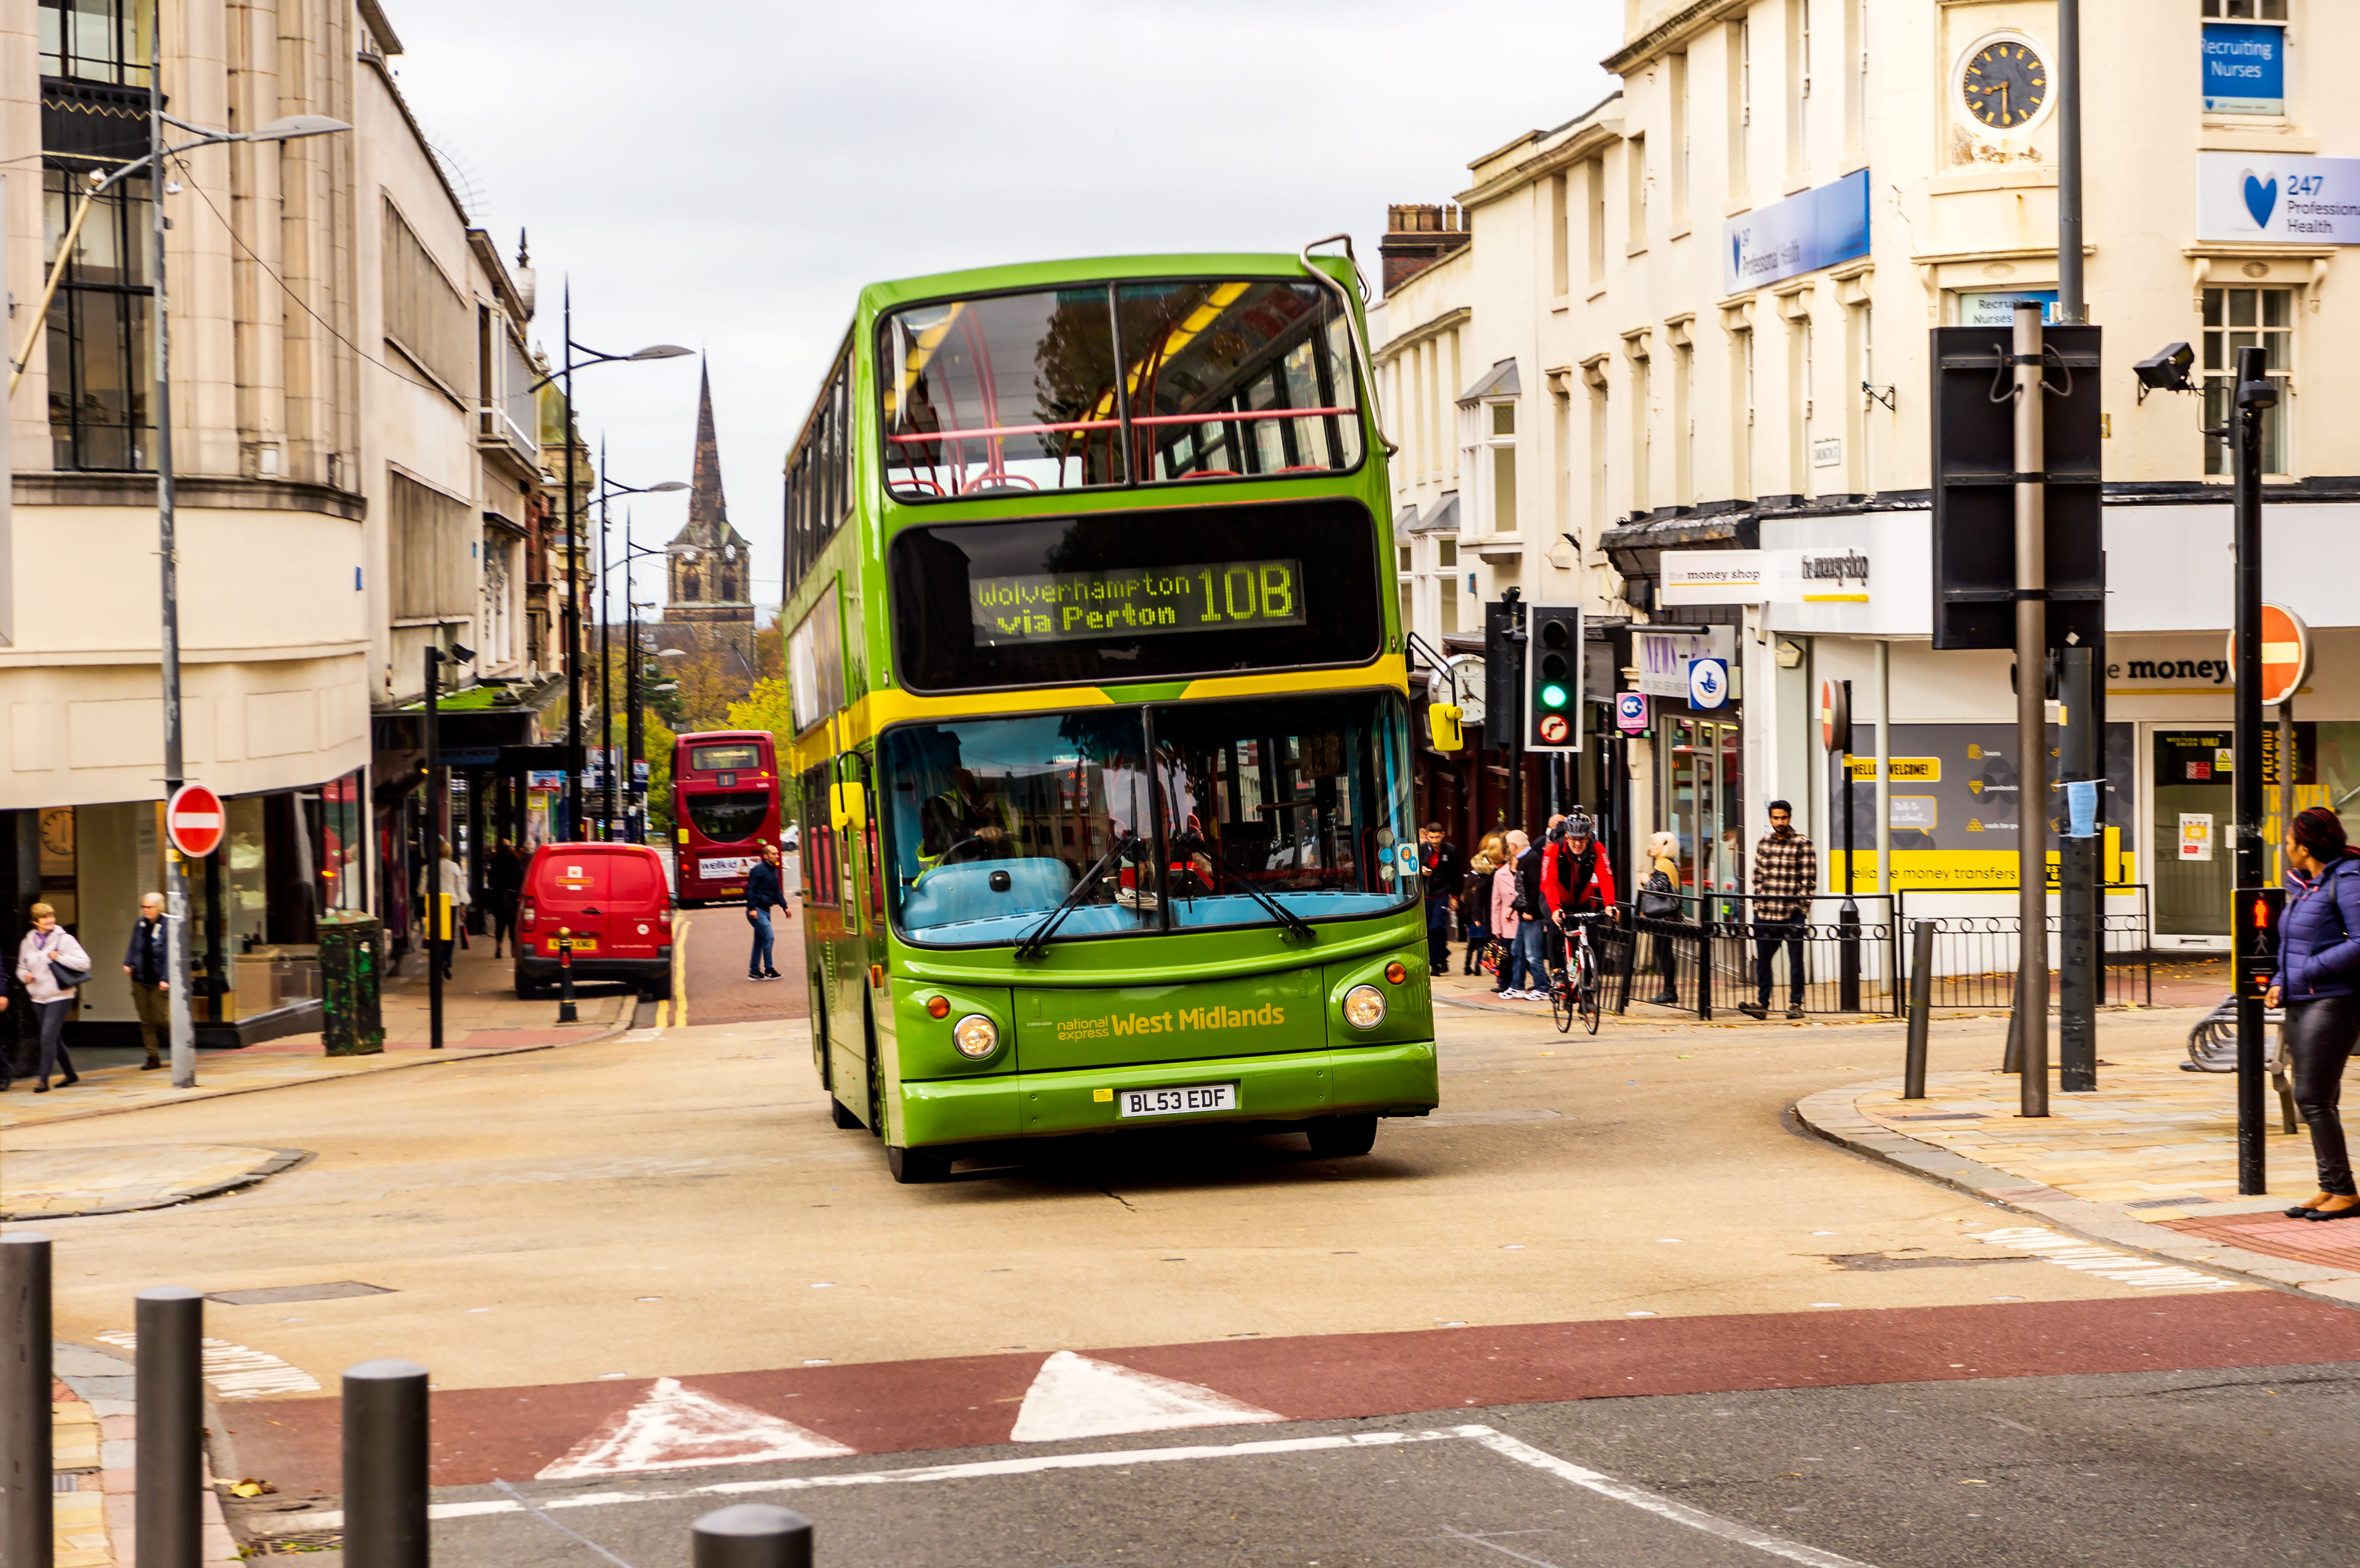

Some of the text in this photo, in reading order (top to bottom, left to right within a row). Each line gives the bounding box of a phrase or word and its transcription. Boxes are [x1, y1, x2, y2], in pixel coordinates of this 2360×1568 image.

[2201, 38, 2273, 60] Recruiting
[2211, 61, 2262, 78] Nurses
[2287, 175, 2323, 195] 247
[2287, 219, 2333, 233] Health
[1973, 314, 2013, 324] Nurses
[1687, 571, 1728, 581] money
[1731, 569, 1761, 580] shop
[978, 563, 1292, 622] Wolverhampton 10B
[997, 603, 1176, 635] via Perton
[1646, 635, 1677, 676] NEWS
[2128, 660, 2227, 684] money
[724, 775, 729, 785] 1
[1852, 866, 2016, 881] eliae money transfers
[1057, 1015, 1108, 1030] national
[1111, 1003, 1284, 1036] West Midlands
[1058, 1028, 1109, 1043] express
[1130, 1091, 1182, 1113] BL53
[1187, 1088, 1225, 1108] EDF
